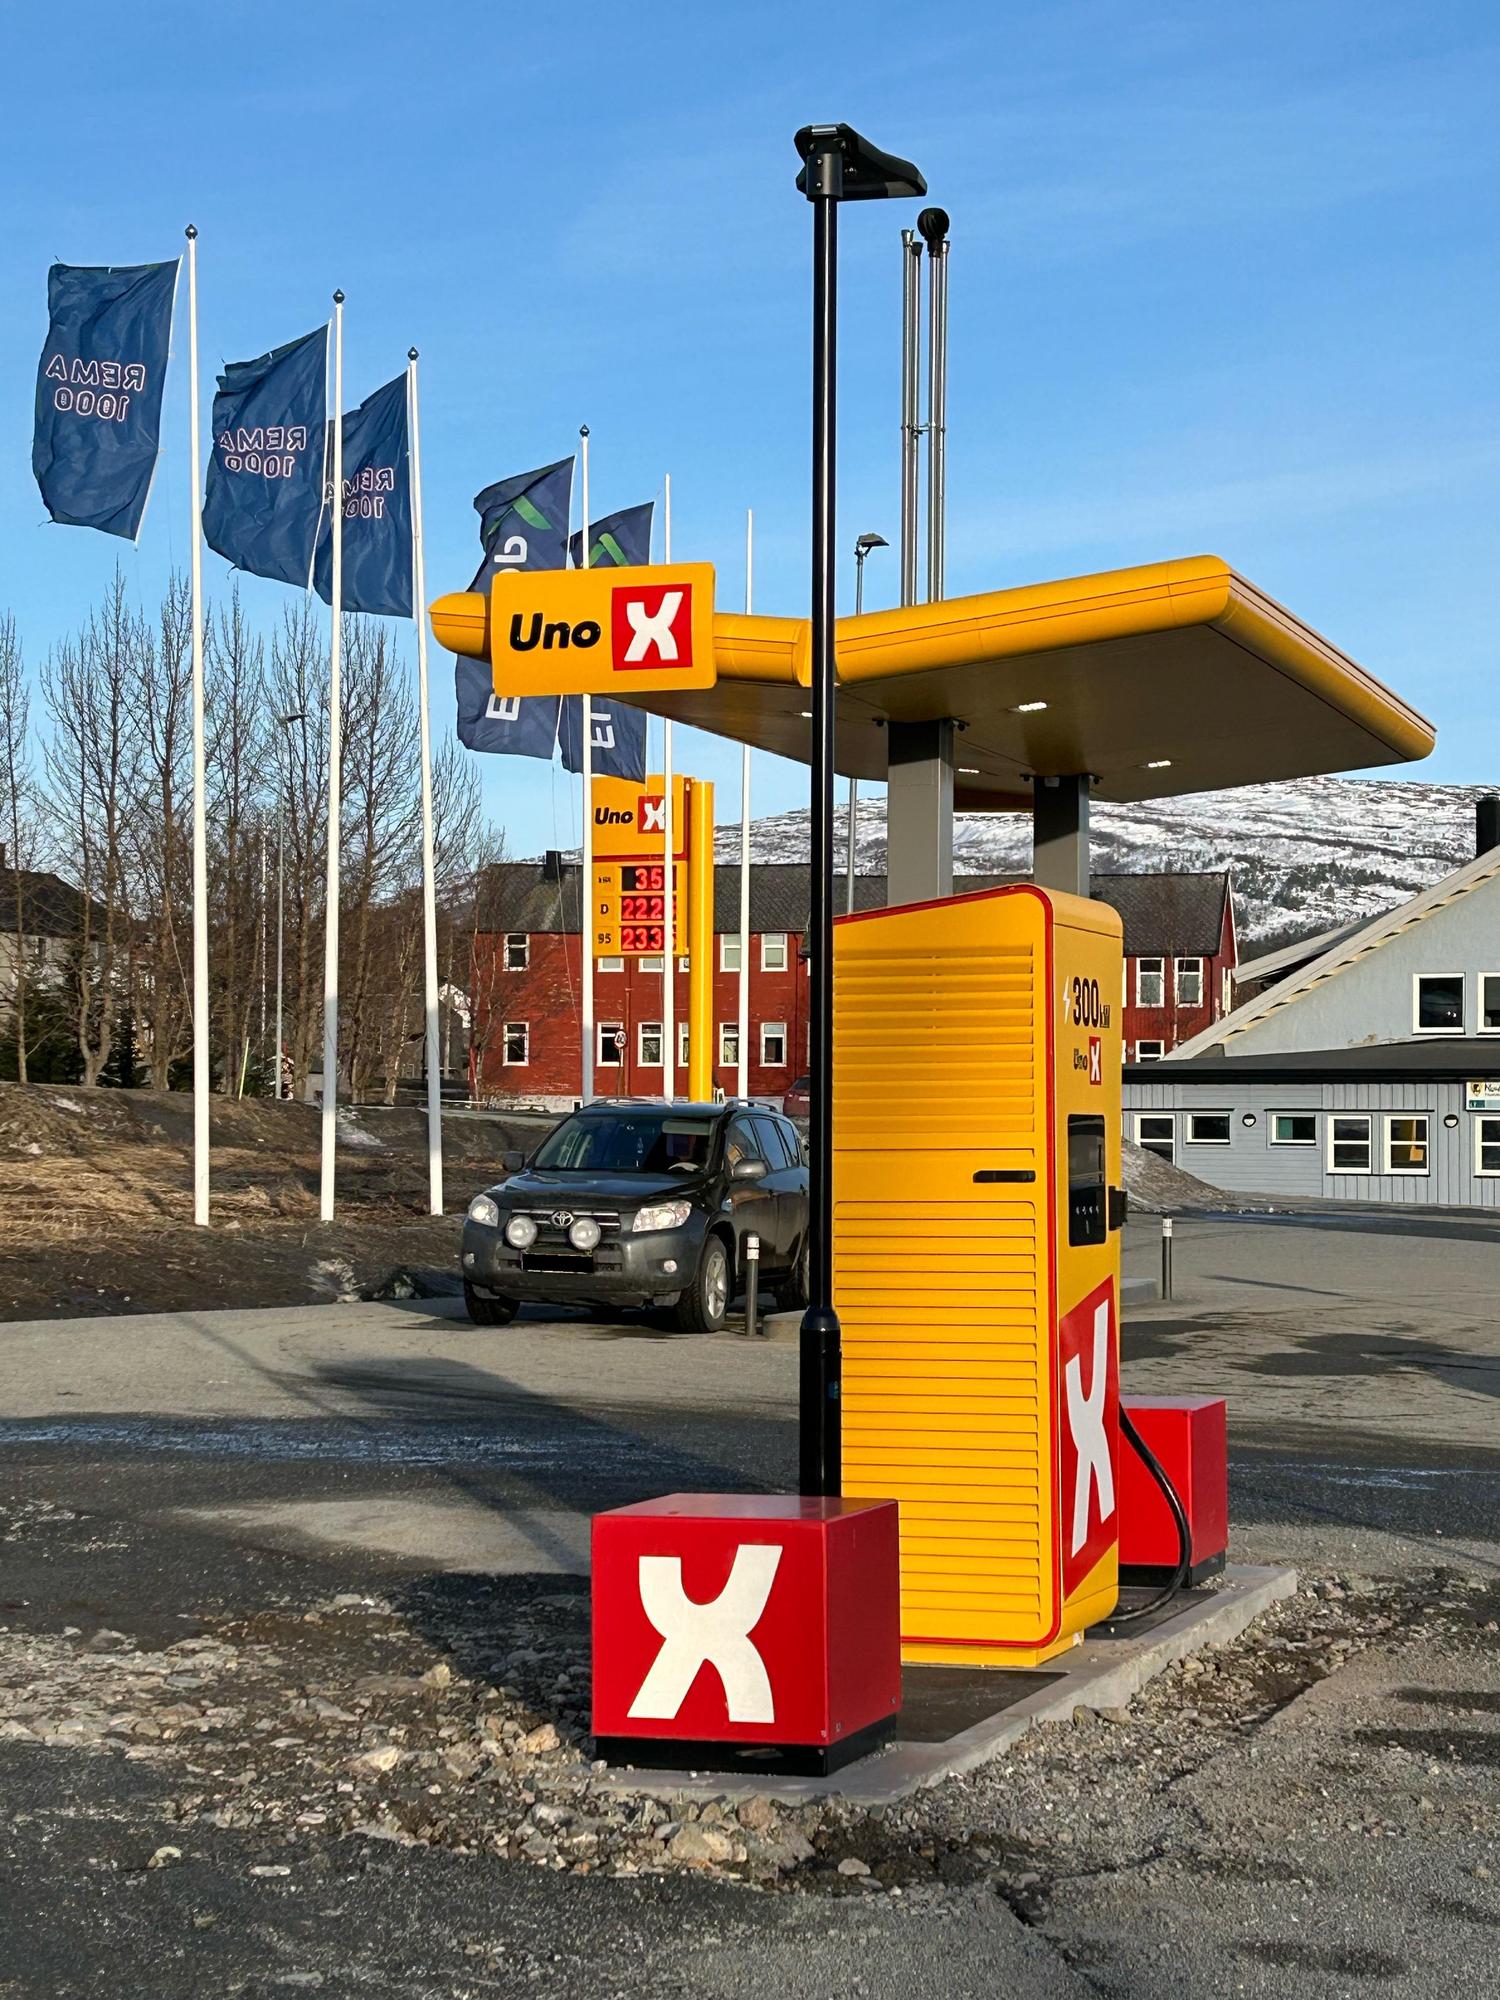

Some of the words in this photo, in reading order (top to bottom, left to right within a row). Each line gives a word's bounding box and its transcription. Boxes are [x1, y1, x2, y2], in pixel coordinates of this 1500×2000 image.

[510, 612, 601, 651] Uno
[624, 592, 683, 661] X
[594, 807, 633, 825] Uno
[643, 799, 668, 830] X
[1073, 976, 1099, 1028] 300
[1090, 1041, 1101, 1081] X
[1065, 1299, 1115, 1558] X
[627, 1544, 783, 1723] X
